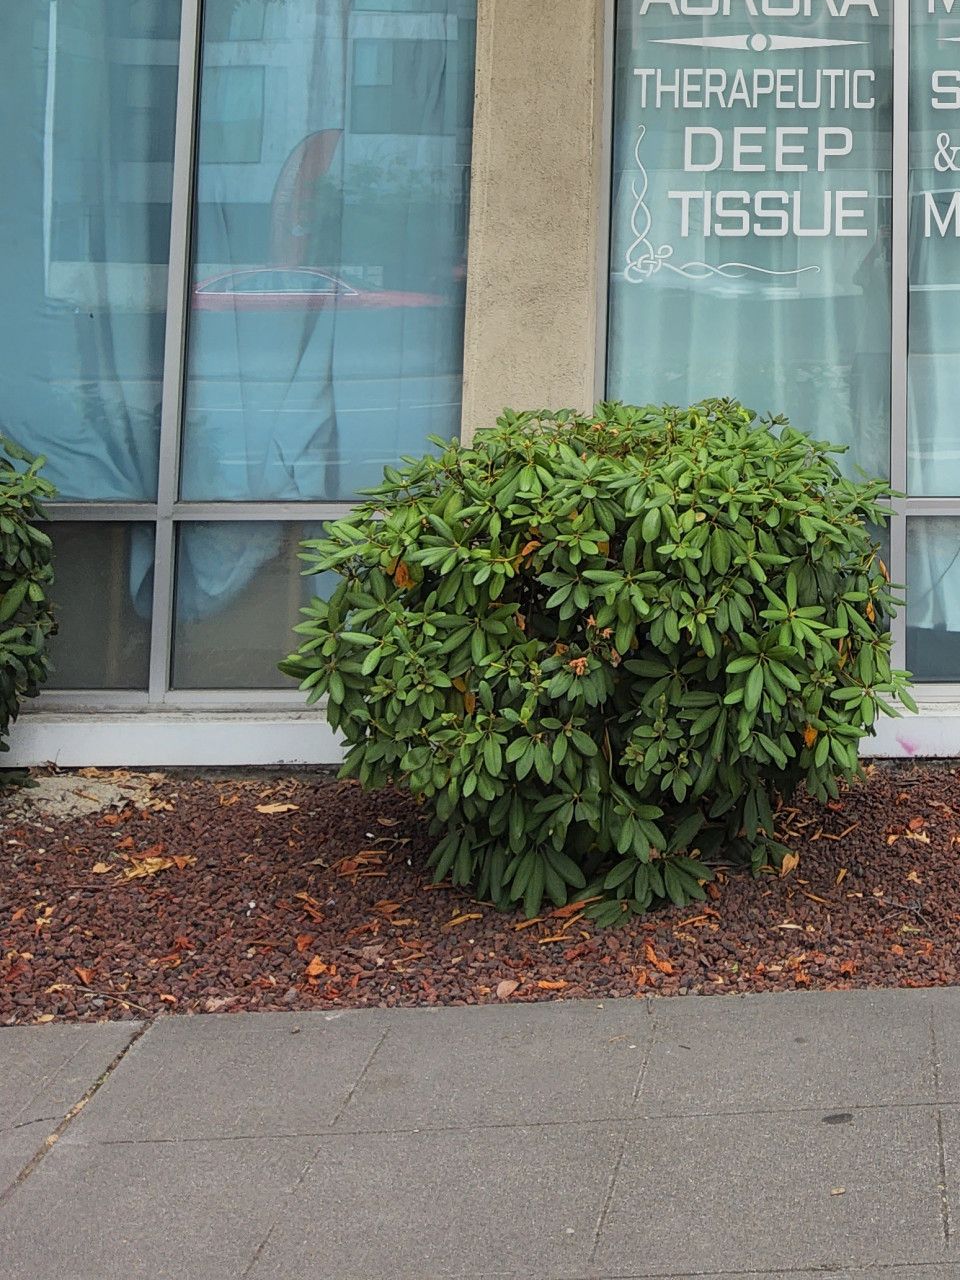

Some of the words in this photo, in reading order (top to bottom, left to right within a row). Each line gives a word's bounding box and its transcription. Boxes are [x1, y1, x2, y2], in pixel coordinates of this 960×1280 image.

[634, 68, 875, 109] THERAPEUTIC
[684, 126, 853, 172] DEEP
[668, 191, 868, 237] TISSUE
